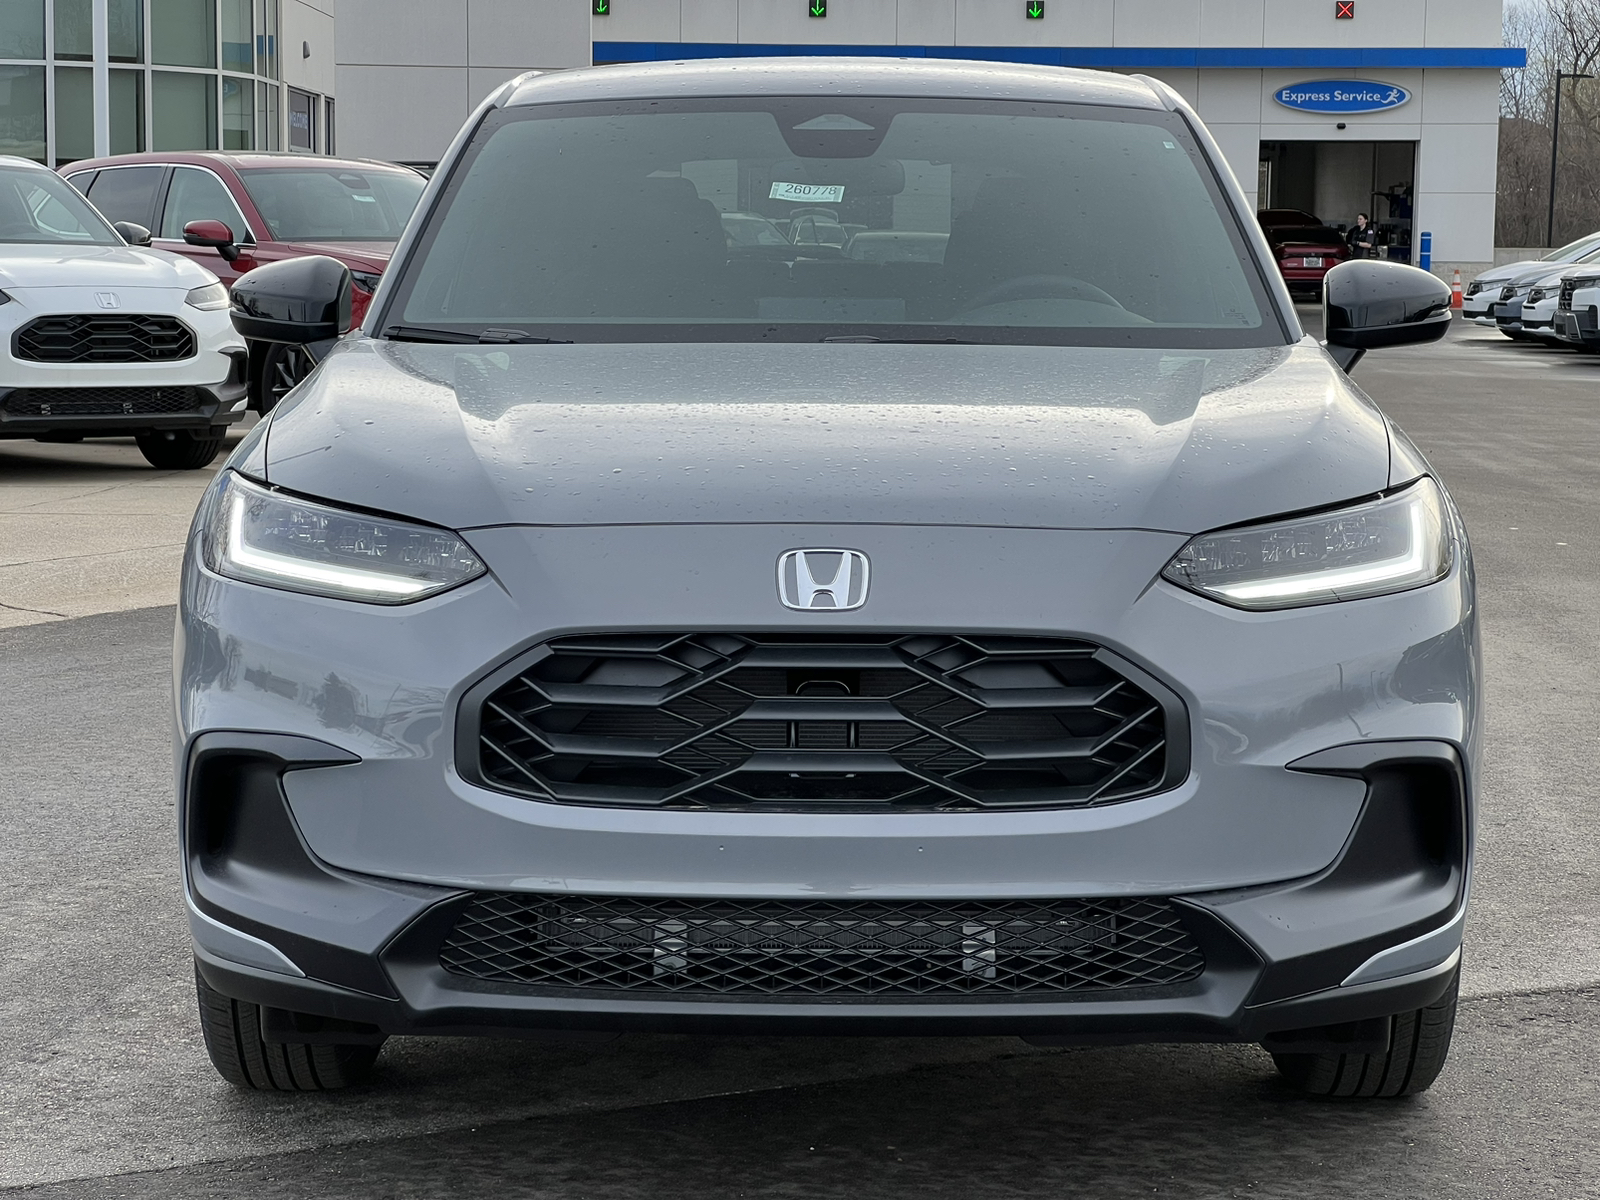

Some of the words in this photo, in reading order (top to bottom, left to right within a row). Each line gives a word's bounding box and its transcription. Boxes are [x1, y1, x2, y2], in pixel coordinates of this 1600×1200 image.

[1281, 90, 1330, 104] Express
[1333, 90, 1381, 101] Service
[785, 183, 837, 195] 260778
